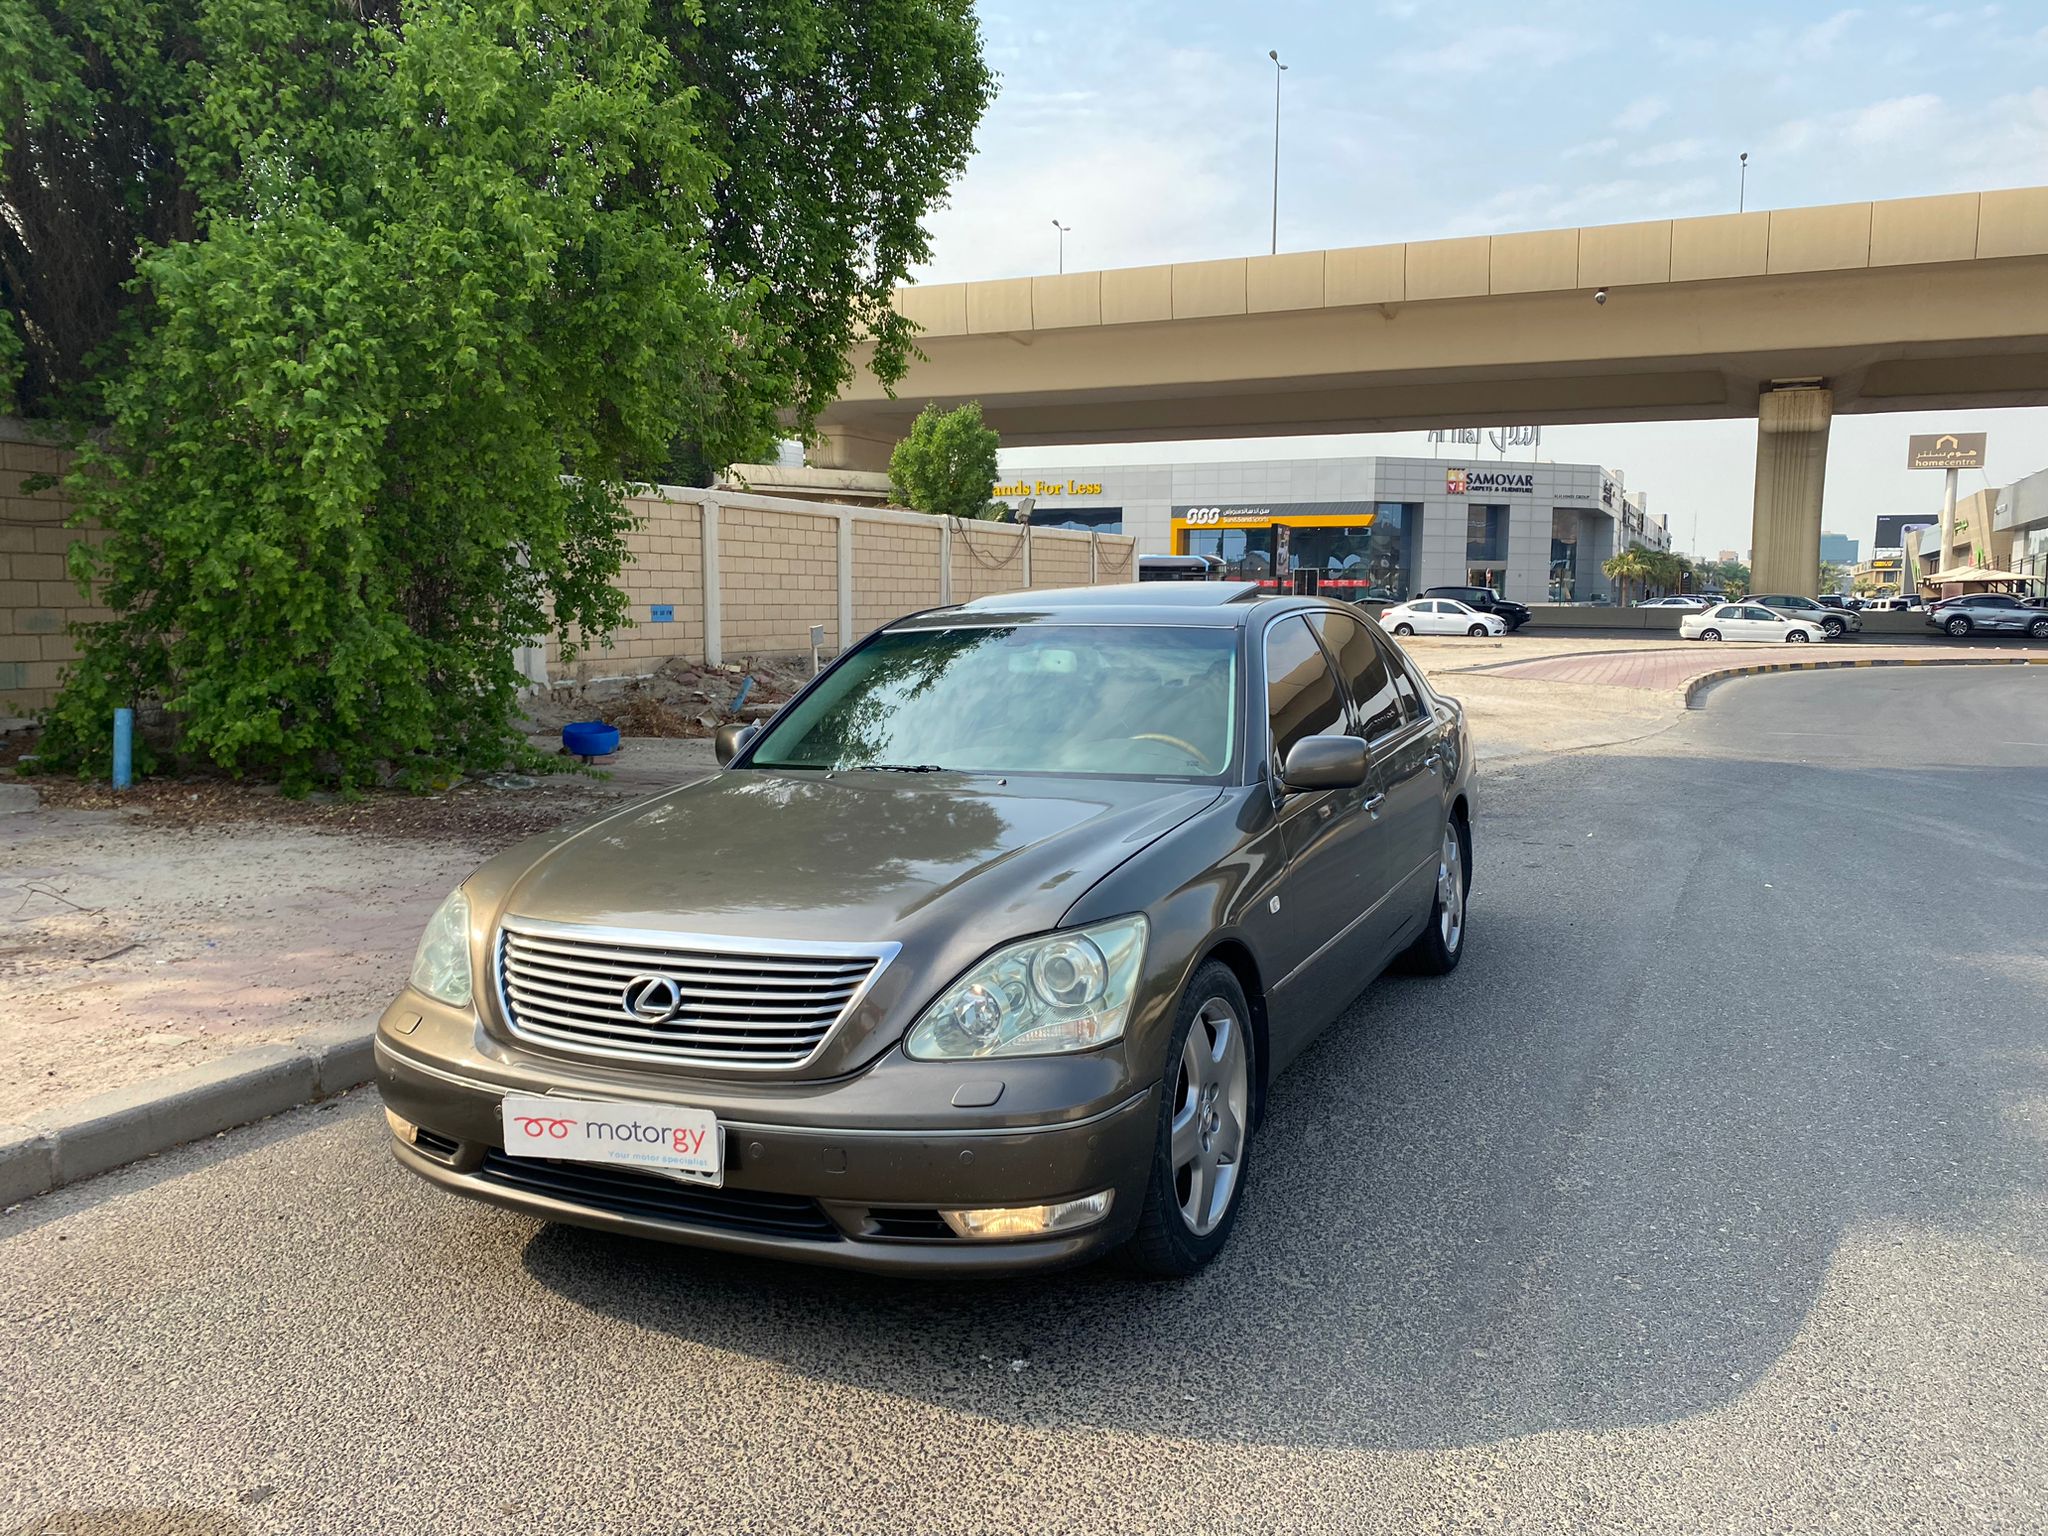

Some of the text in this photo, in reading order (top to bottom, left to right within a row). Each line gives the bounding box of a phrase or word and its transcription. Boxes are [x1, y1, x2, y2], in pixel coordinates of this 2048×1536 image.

[1916, 450, 1977, 459] هوم سنتر
[1915, 459, 1977, 467] homecentre
[1466, 473, 1533, 487] SAMOVAR
[992, 480, 1102, 497] ands For Less
[1466, 485, 1493, 493] CARPETS
[1501, 486, 1533, 494] FURNITURE
[586, 1121, 705, 1154] motorgy
[608, 1150, 707, 1167] Your motor specialist
